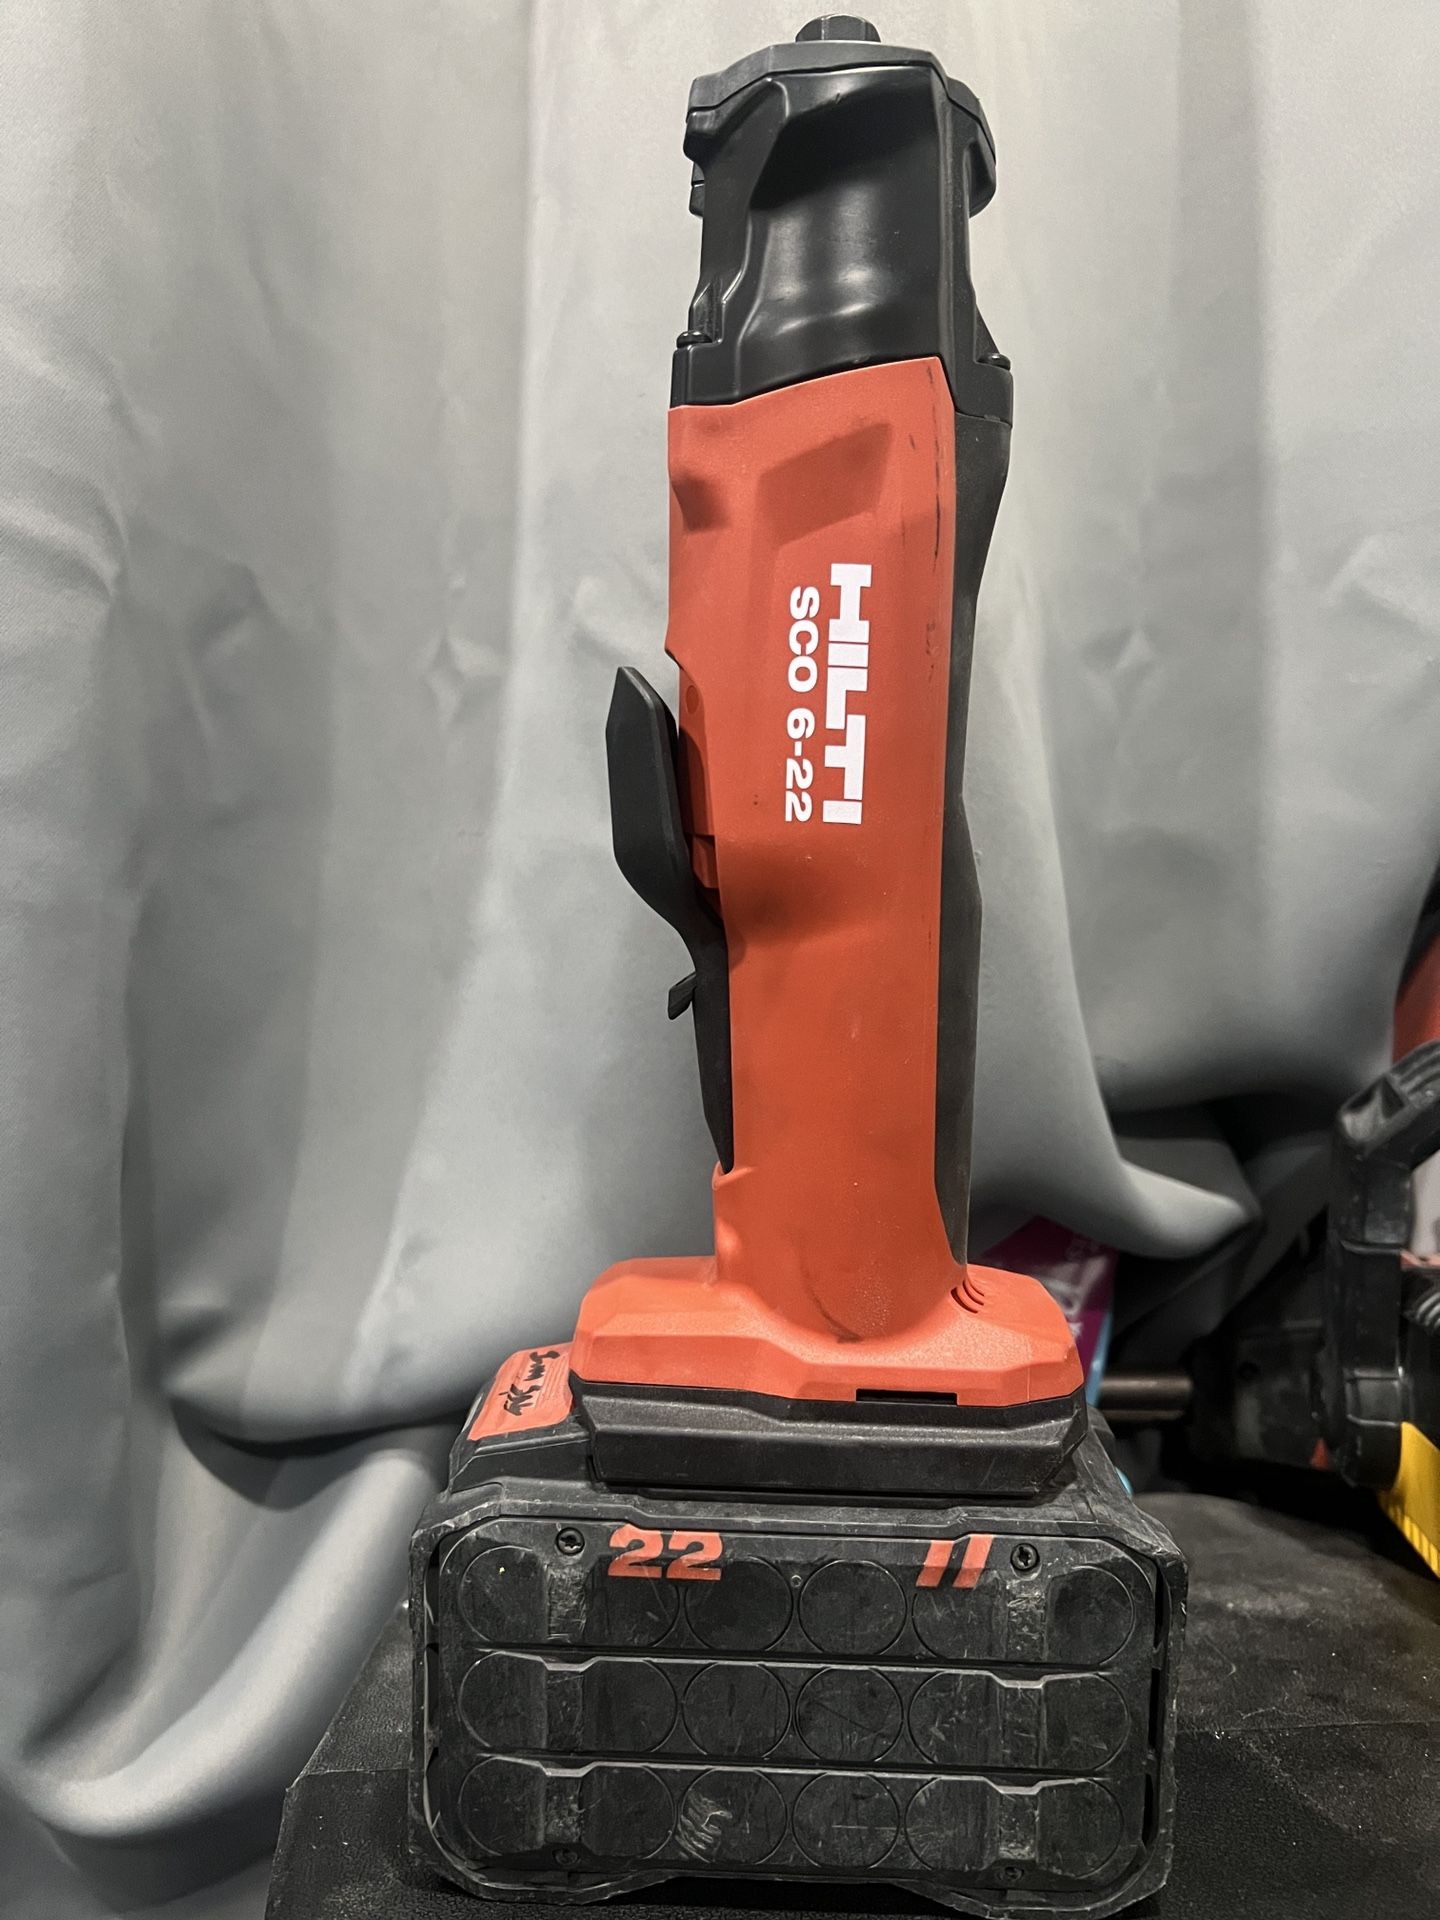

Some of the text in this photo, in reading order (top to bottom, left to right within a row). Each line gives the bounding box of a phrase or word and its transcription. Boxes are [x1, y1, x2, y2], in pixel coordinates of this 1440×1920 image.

[785, 586, 820, 822] SCO 6-22
[822, 563, 872, 825] HILTI
[607, 1523, 723, 1582] 22
